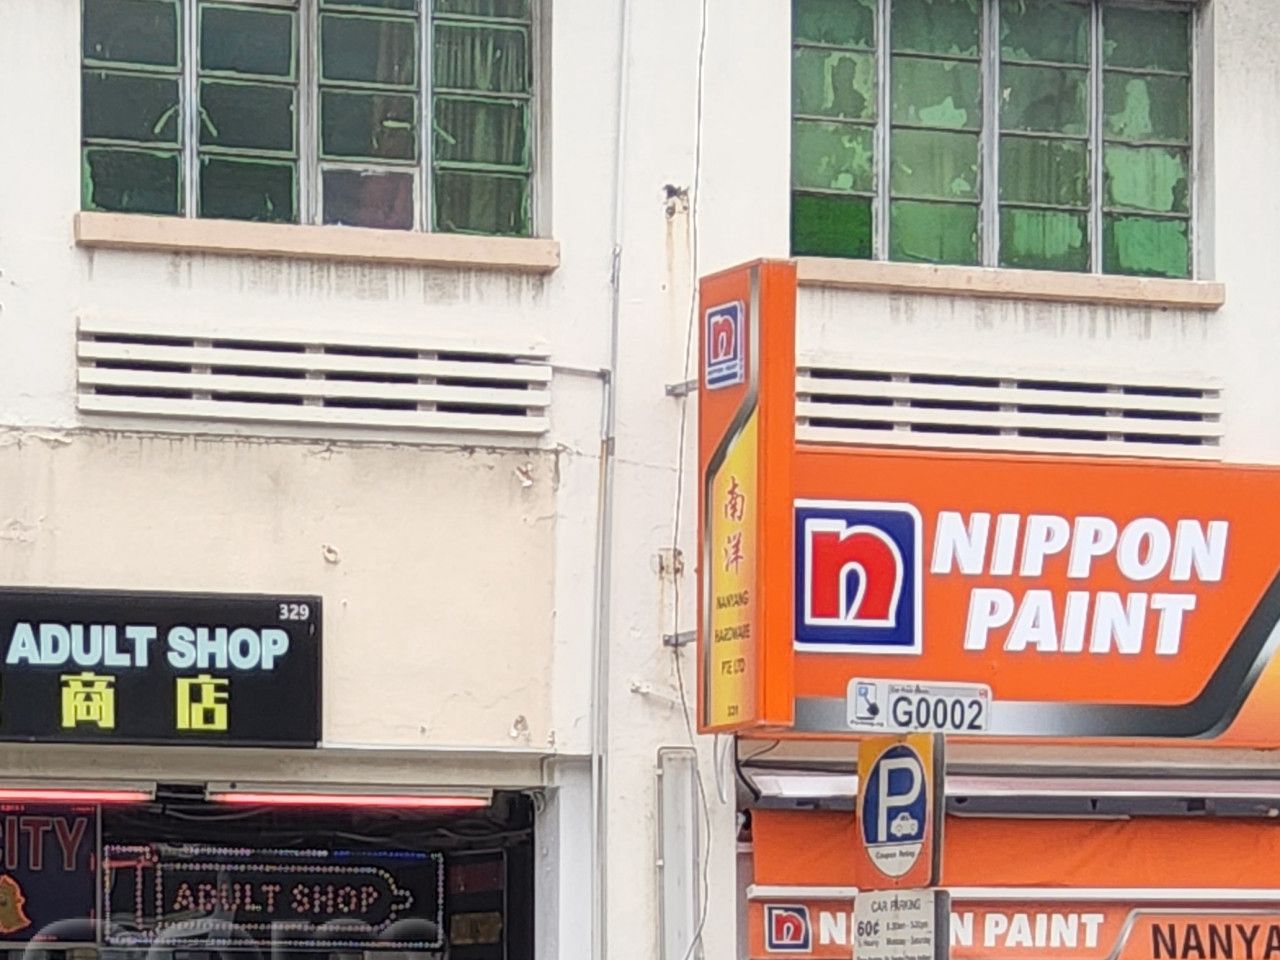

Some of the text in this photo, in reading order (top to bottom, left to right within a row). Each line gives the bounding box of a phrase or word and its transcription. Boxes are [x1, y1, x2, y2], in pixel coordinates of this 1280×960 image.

[724, 476, 746, 574] 南洋
[930, 512, 1229, 582] NIPPON
[279, 603, 310, 621] 329
[964, 588, 1197, 655] PAINT
[7, 623, 157, 668] ADULT
[167, 627, 290, 670] SHOP
[892, 696, 983, 730] G0002
[878, 757, 922, 841] P
[173, 881, 380, 914] ADULT SHOP
[984, 913, 1104, 948] PAINT
